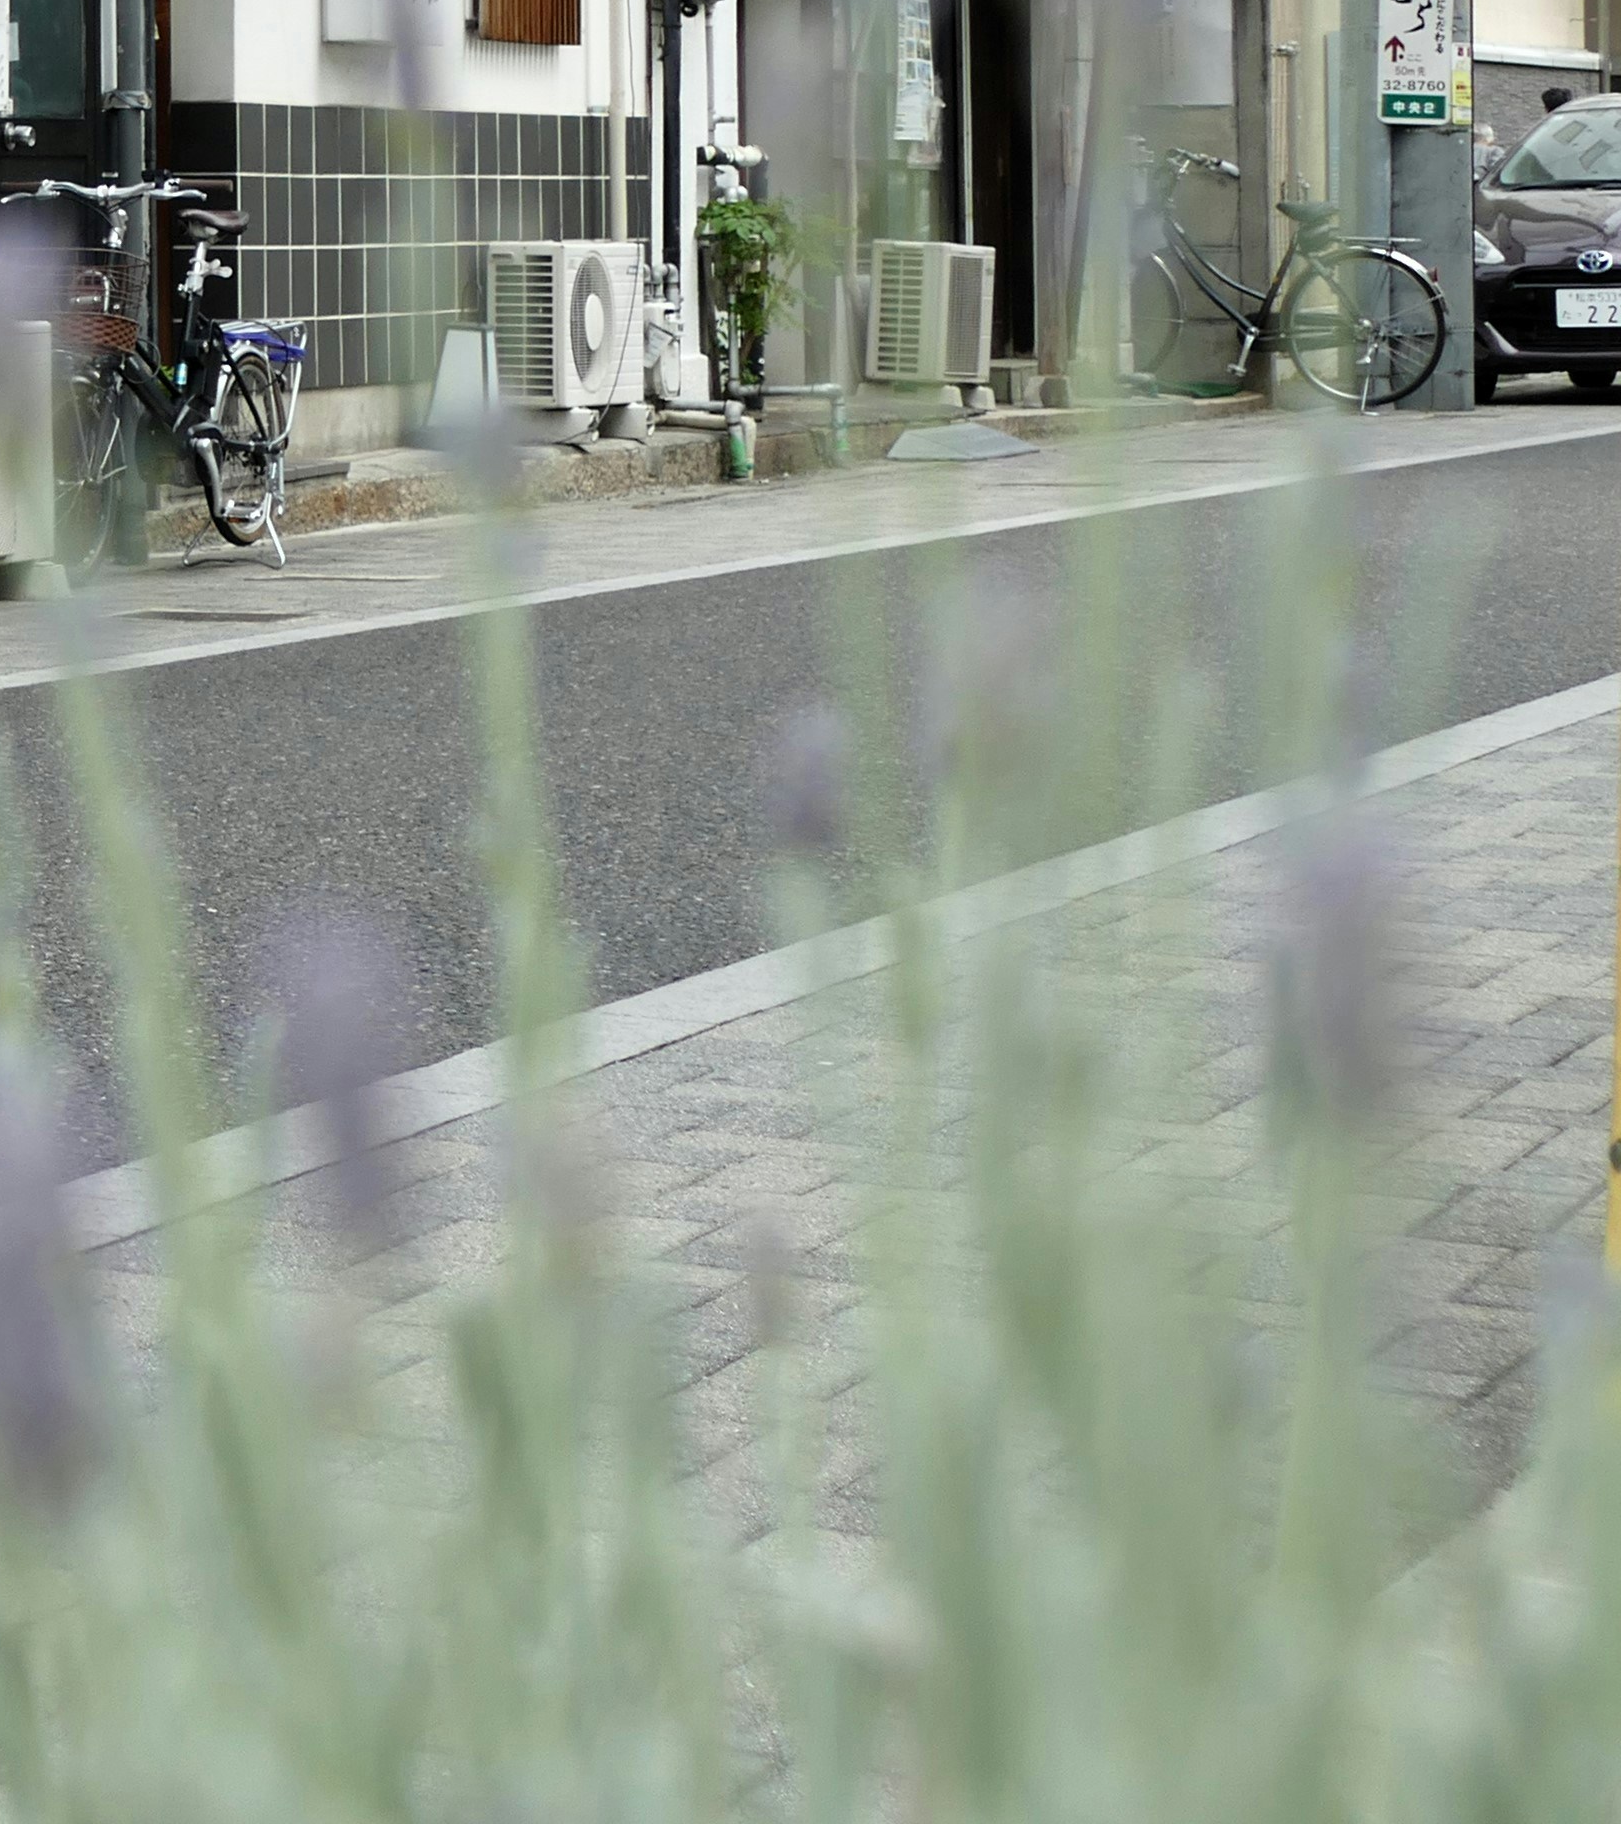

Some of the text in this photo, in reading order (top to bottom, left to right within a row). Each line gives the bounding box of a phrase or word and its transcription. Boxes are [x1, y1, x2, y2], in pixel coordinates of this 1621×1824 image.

[1394, 66, 1415, 78] 50m
[1382, 79, 1446, 92] 32-8760
[1392, 100, 1436, 114] 中央2
